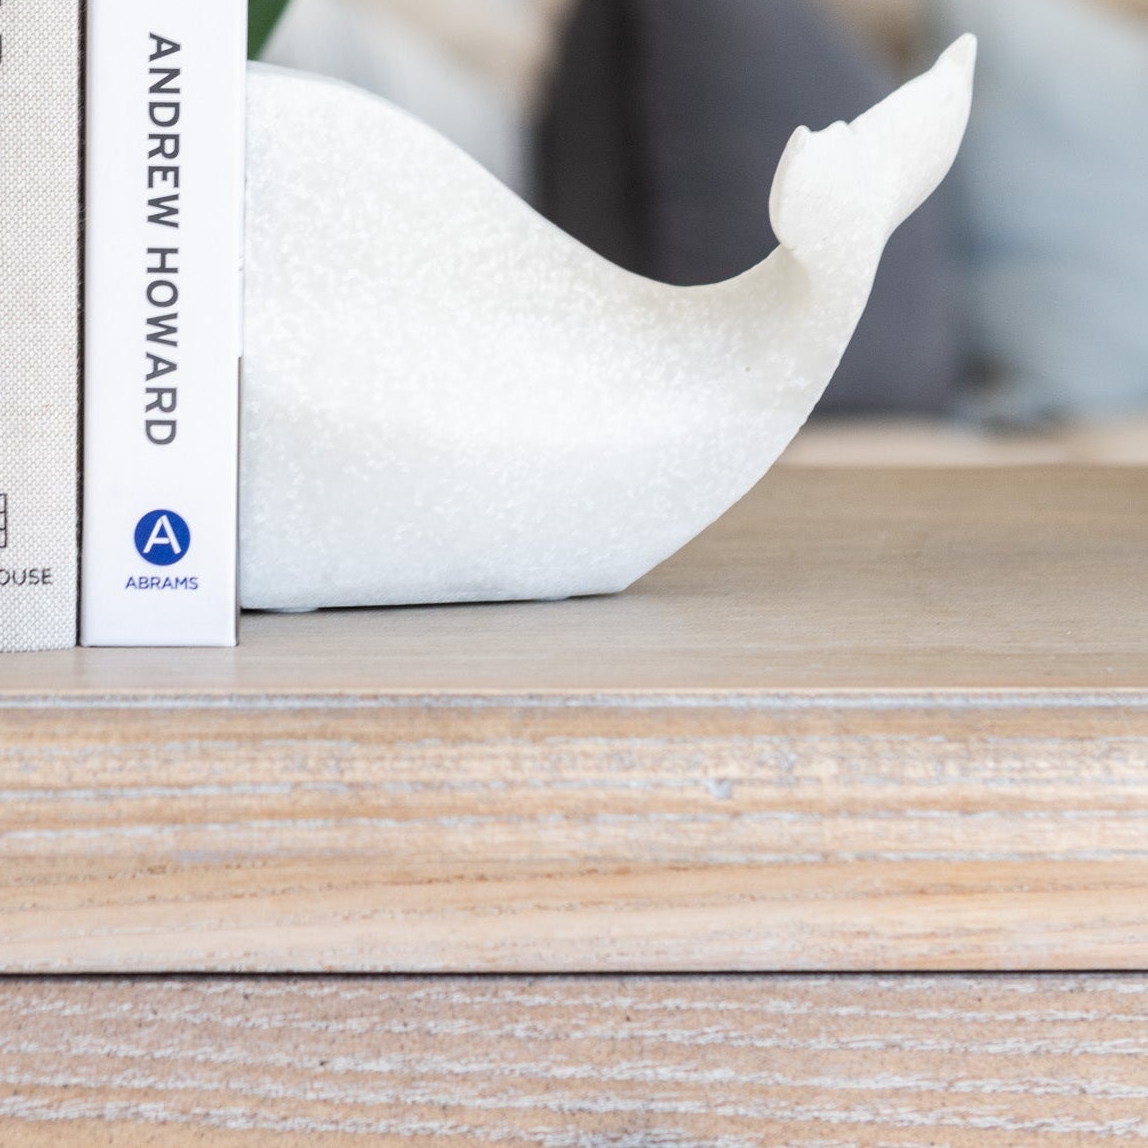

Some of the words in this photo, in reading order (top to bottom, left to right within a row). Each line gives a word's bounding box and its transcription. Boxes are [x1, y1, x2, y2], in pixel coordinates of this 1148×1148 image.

[147, 32, 181, 229] ANDREW
[145, 247, 180, 446] HOWARD
[125, 575, 199, 590] ABRAMS
[142, 514, 182, 556] A
